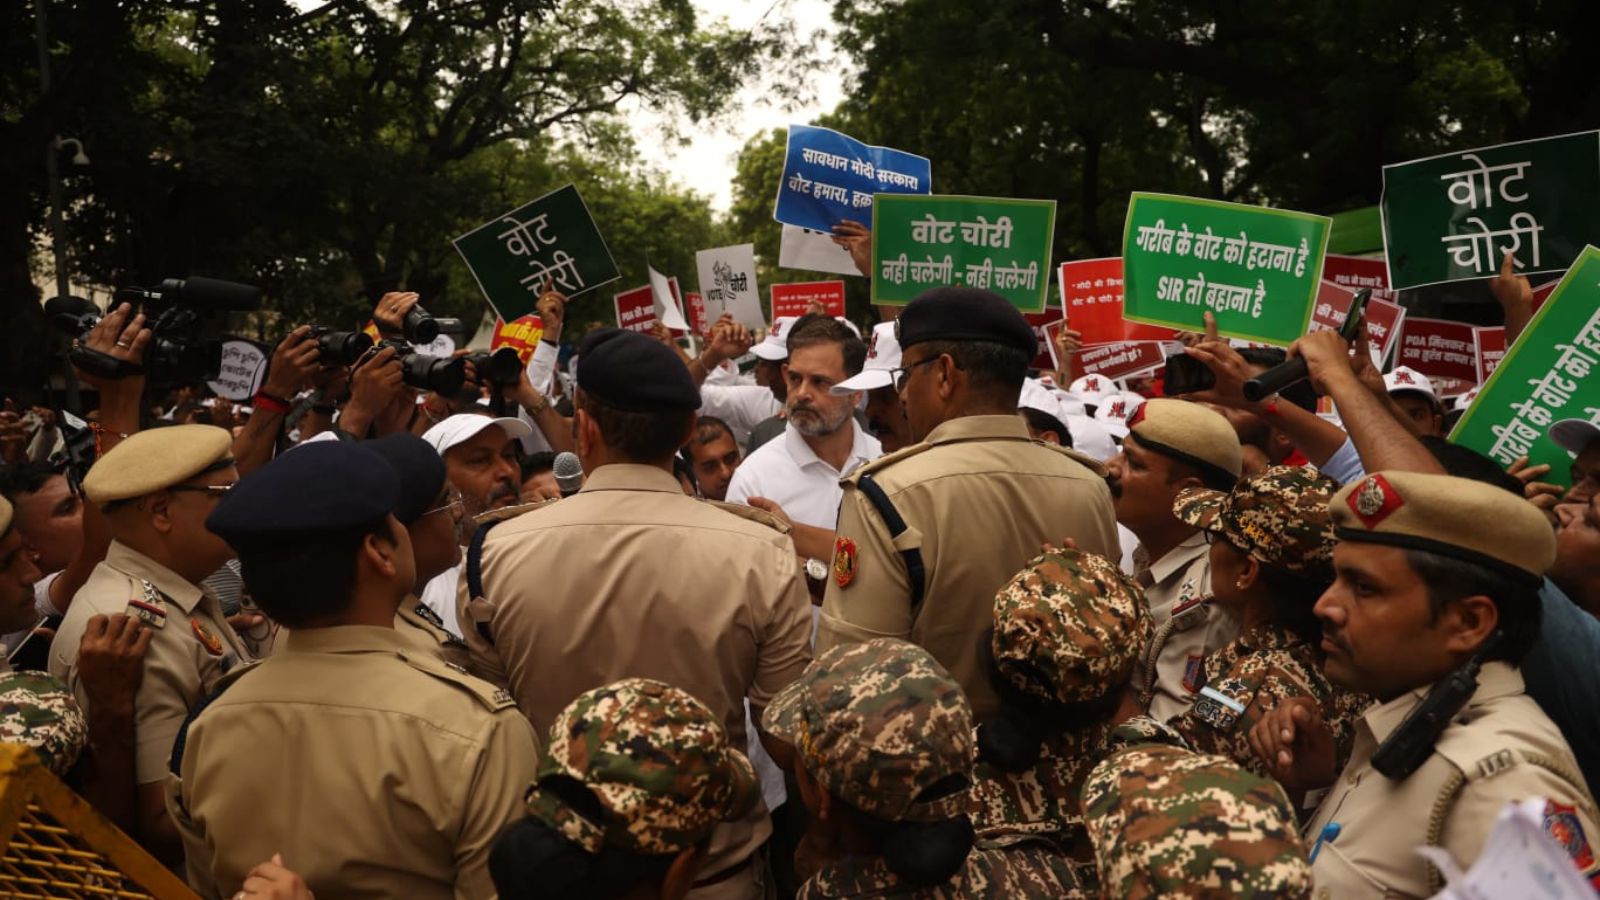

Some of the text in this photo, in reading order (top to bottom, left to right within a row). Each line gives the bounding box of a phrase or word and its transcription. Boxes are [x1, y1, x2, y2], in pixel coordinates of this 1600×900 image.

[802, 148, 849, 172] सावधान
[850, 157, 875, 180] मोदी
[1441, 154, 1532, 209] वोट
[788, 172, 812, 193] वोट
[813, 182, 849, 206] हमारा,
[498, 213, 557, 256] वोट
[911, 213, 1014, 248] वोट चोरी
[1136, 219, 1310, 278] गरीब के वोट को हटाना है
[1441, 212, 1544, 272] चोरी
[910, 254, 953, 285] चलेगी
[995, 260, 1038, 290] चलेगी
[706, 289, 723, 301] VOTE
[1156, 272, 1266, 318] SIR तो बहाना है
[1554, 343, 1598, 379] को
[1528, 369, 1577, 408] वोट
[1510, 399, 1552, 427] के
[1489, 417, 1541, 465] गरीब
